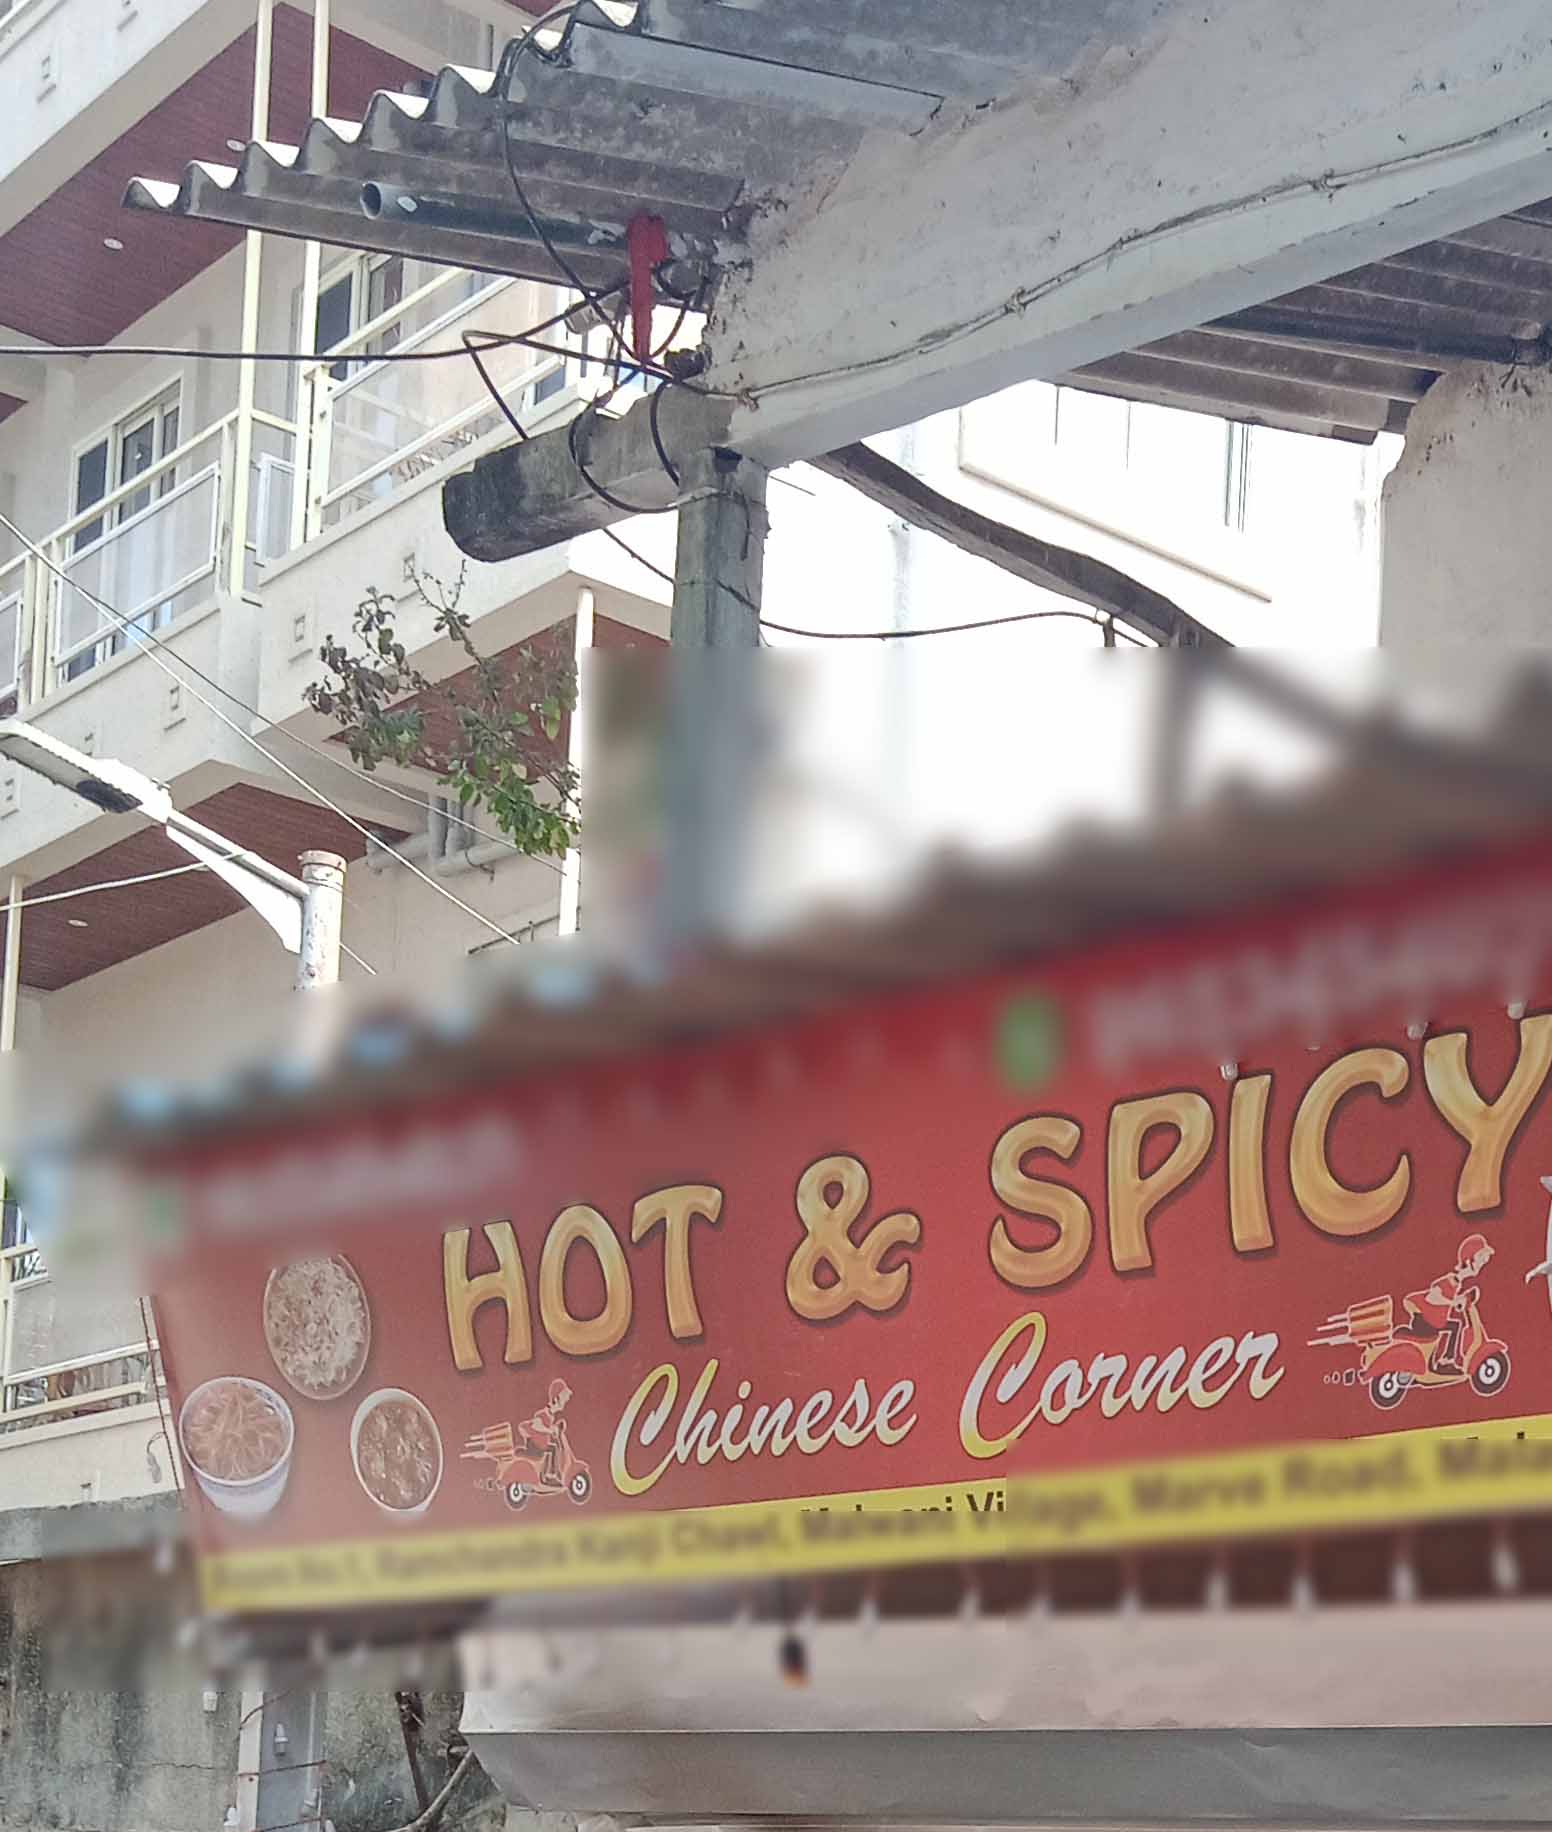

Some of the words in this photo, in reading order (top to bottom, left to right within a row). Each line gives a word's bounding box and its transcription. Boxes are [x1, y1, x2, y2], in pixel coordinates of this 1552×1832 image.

[442, 1184, 724, 1371] HOT
[786, 1152, 922, 1320] &
[610, 1358, 918, 1496] Chinese
[959, 1311, 1285, 1461] Corner
